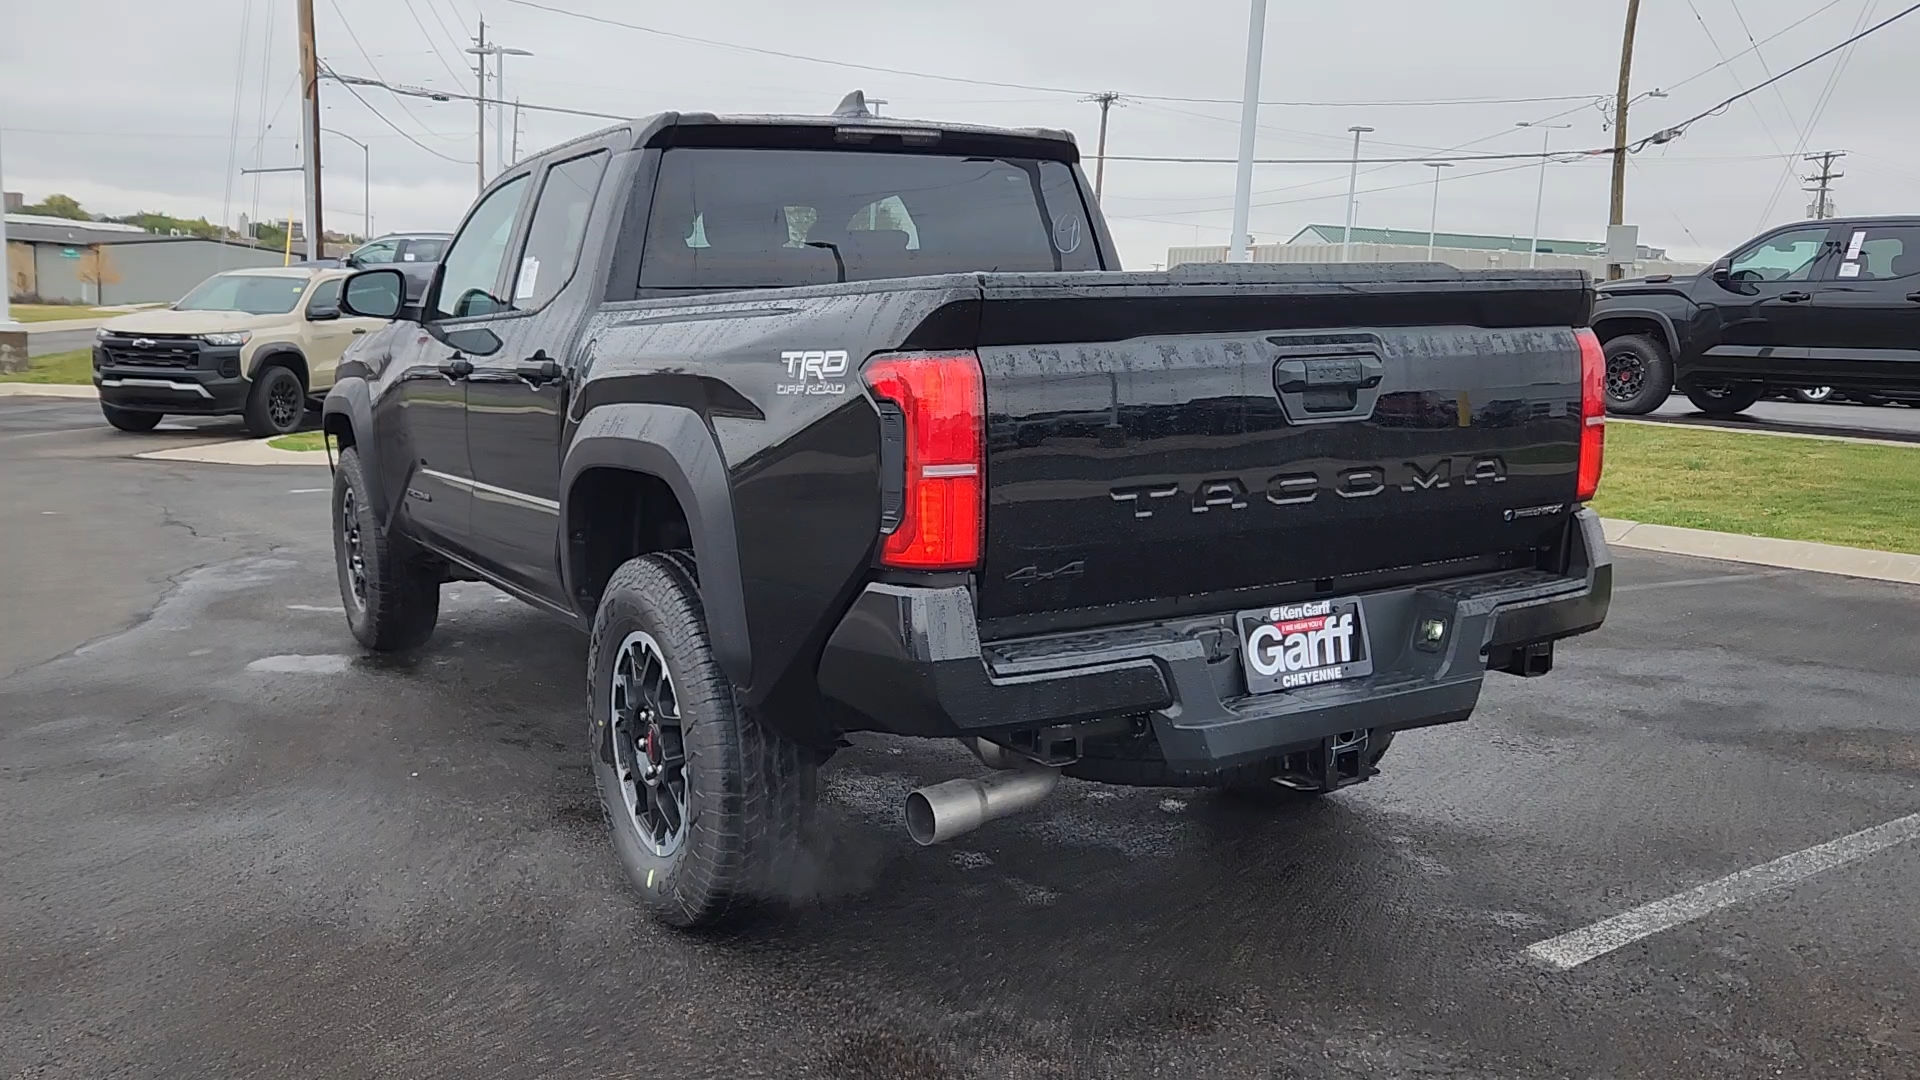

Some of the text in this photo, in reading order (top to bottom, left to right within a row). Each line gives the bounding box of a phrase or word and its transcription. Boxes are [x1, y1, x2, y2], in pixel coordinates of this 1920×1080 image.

[780, 350, 849, 383] TRD
[776, 383, 846, 395] OFF ROAD
[1110, 455, 1508, 519] TACOMA
[1280, 600, 1331, 620] Ken Garff
[1248, 613, 1353, 676] Garff
[1282, 666, 1342, 688] CHEYENNE
